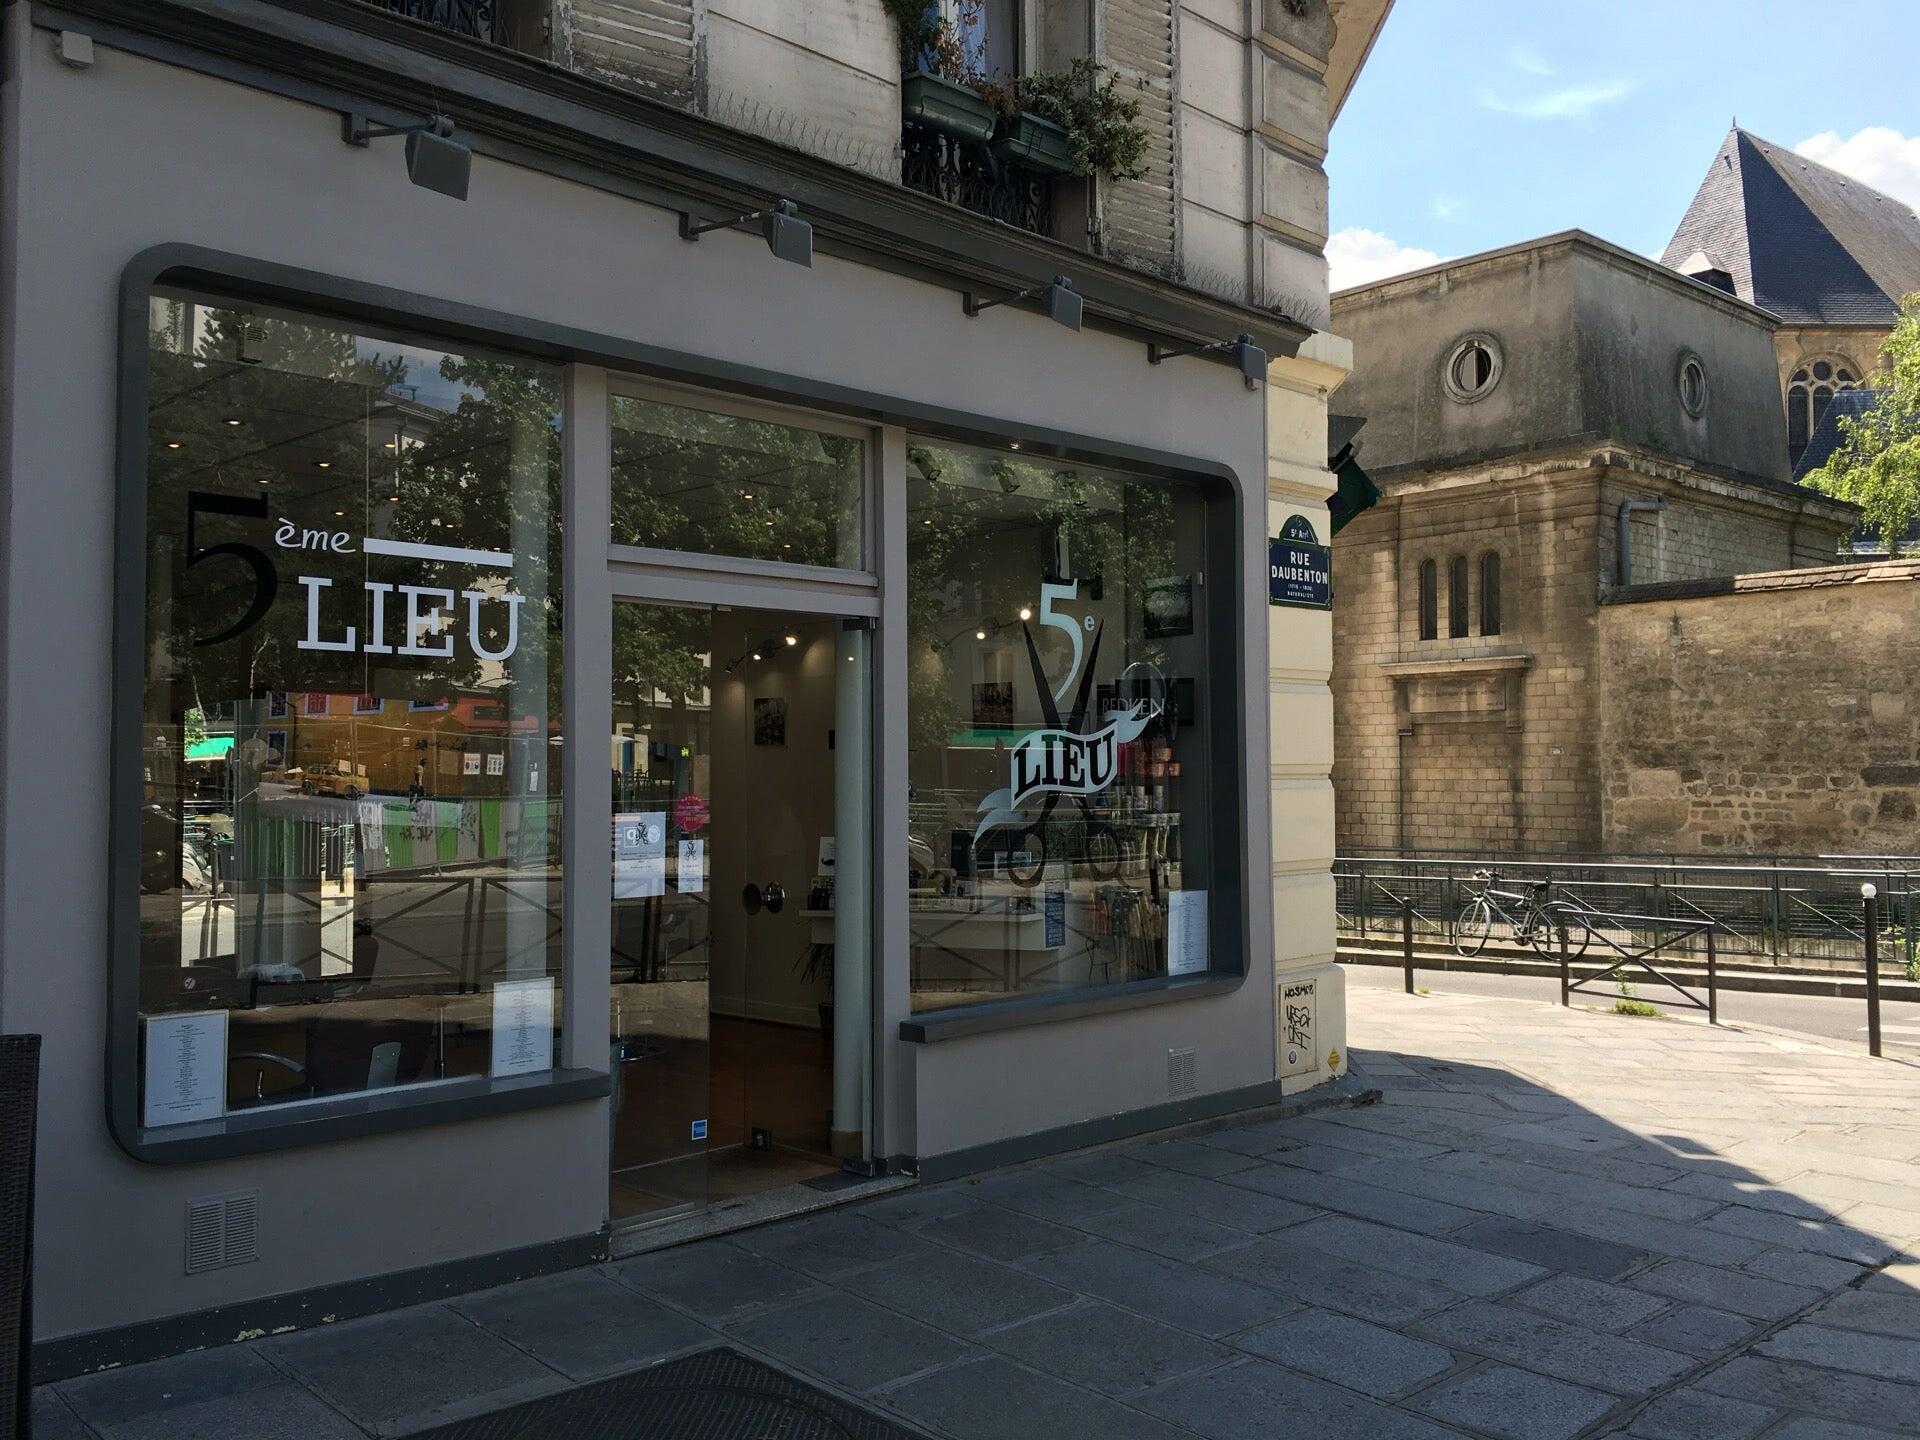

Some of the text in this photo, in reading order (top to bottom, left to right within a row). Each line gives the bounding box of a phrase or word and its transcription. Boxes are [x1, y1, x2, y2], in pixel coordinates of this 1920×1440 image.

[1271, 565, 1328, 585] DAUBENTON
[1291, 552, 1310, 566] RUE
[297, 575, 526, 661] LIEU
[1013, 727, 1116, 802] LIEU
